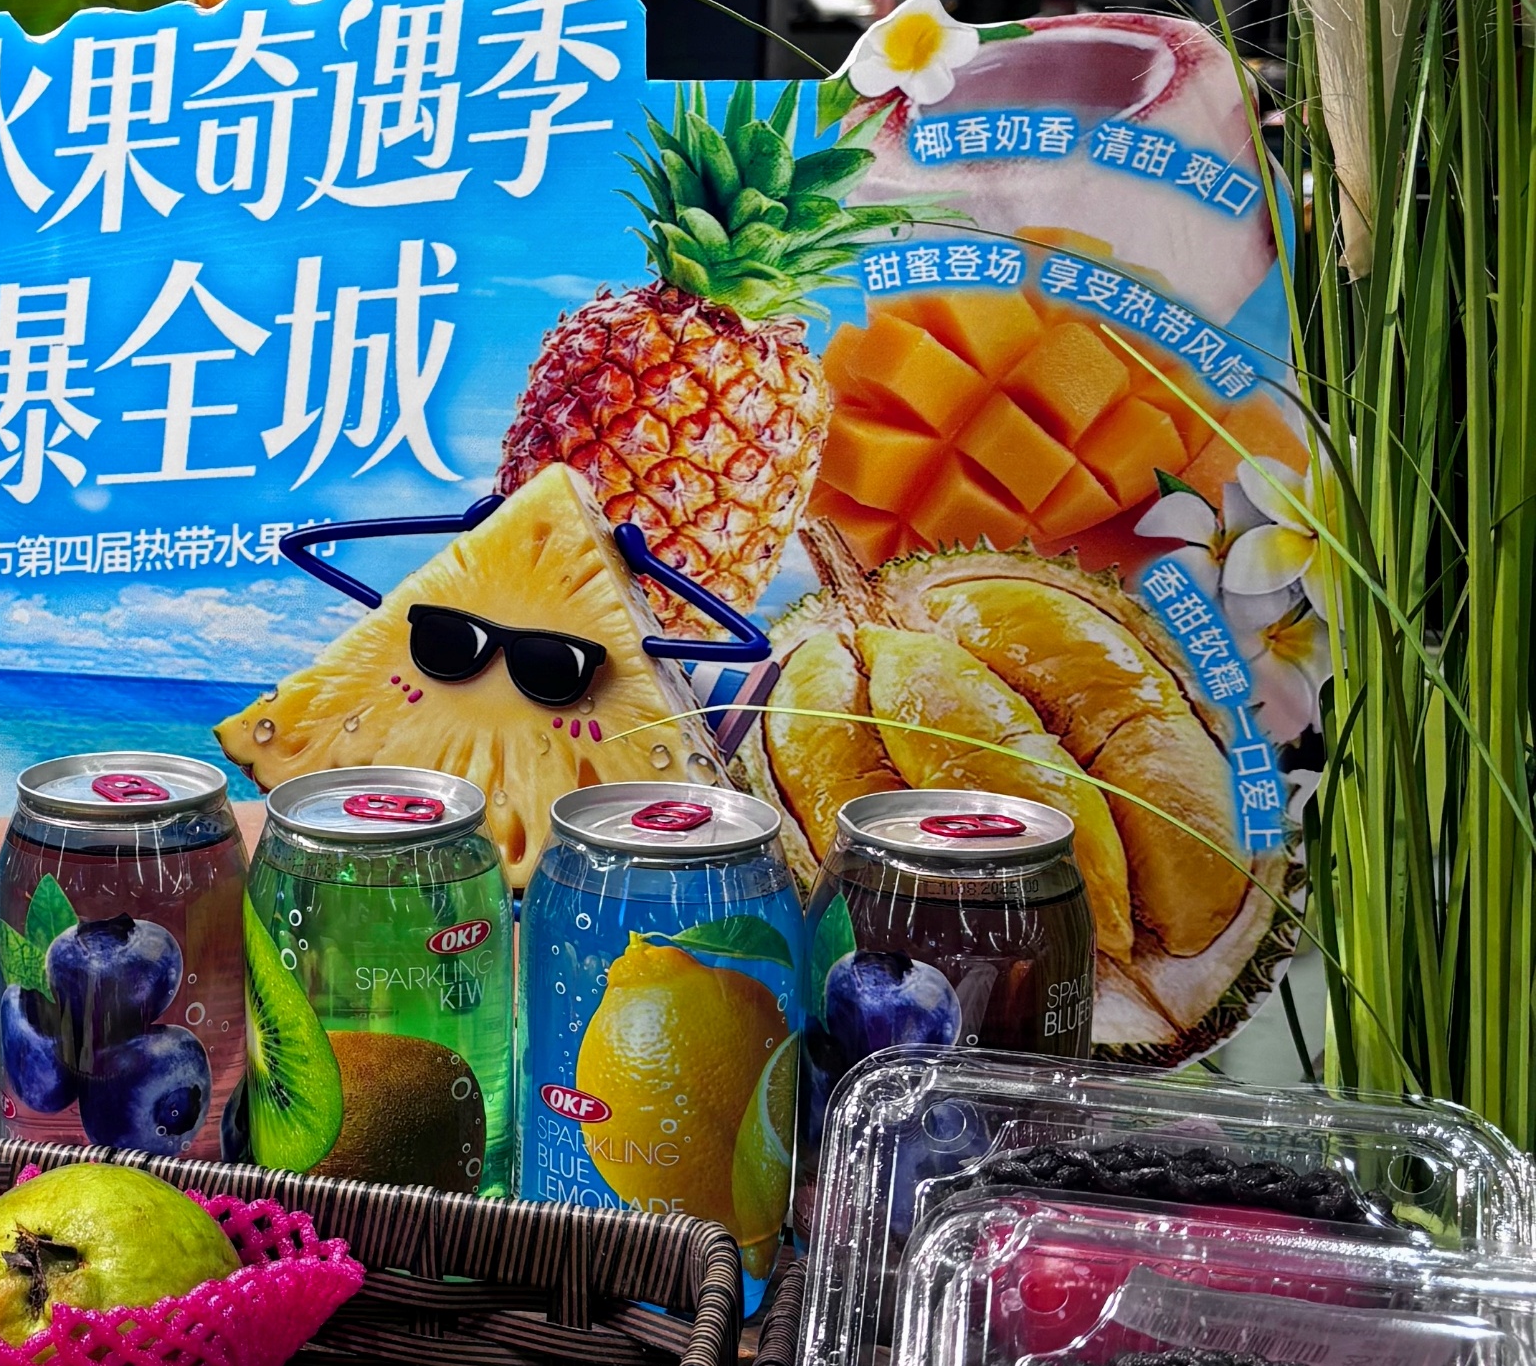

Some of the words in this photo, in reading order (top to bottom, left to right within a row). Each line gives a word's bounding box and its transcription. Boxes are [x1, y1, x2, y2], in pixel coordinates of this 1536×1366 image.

[913, 115, 1074, 164] 椰香奶香
[865, 245, 1023, 292] 甜蜜登场
[1041, 257, 1257, 400] 享受热带风情
[1144, 560, 1250, 703] 香甜软糯
[1231, 703, 1285, 852] 一口爱上
[440, 922, 483, 952] OKF
[355, 949, 494, 991] SPARKLING
[548, 1087, 596, 1117] OKF
[537, 1115, 680, 1167] SPARKLING
[537, 1142, 590, 1184] BLUE
[537, 1169, 685, 1213] LEMONADE
